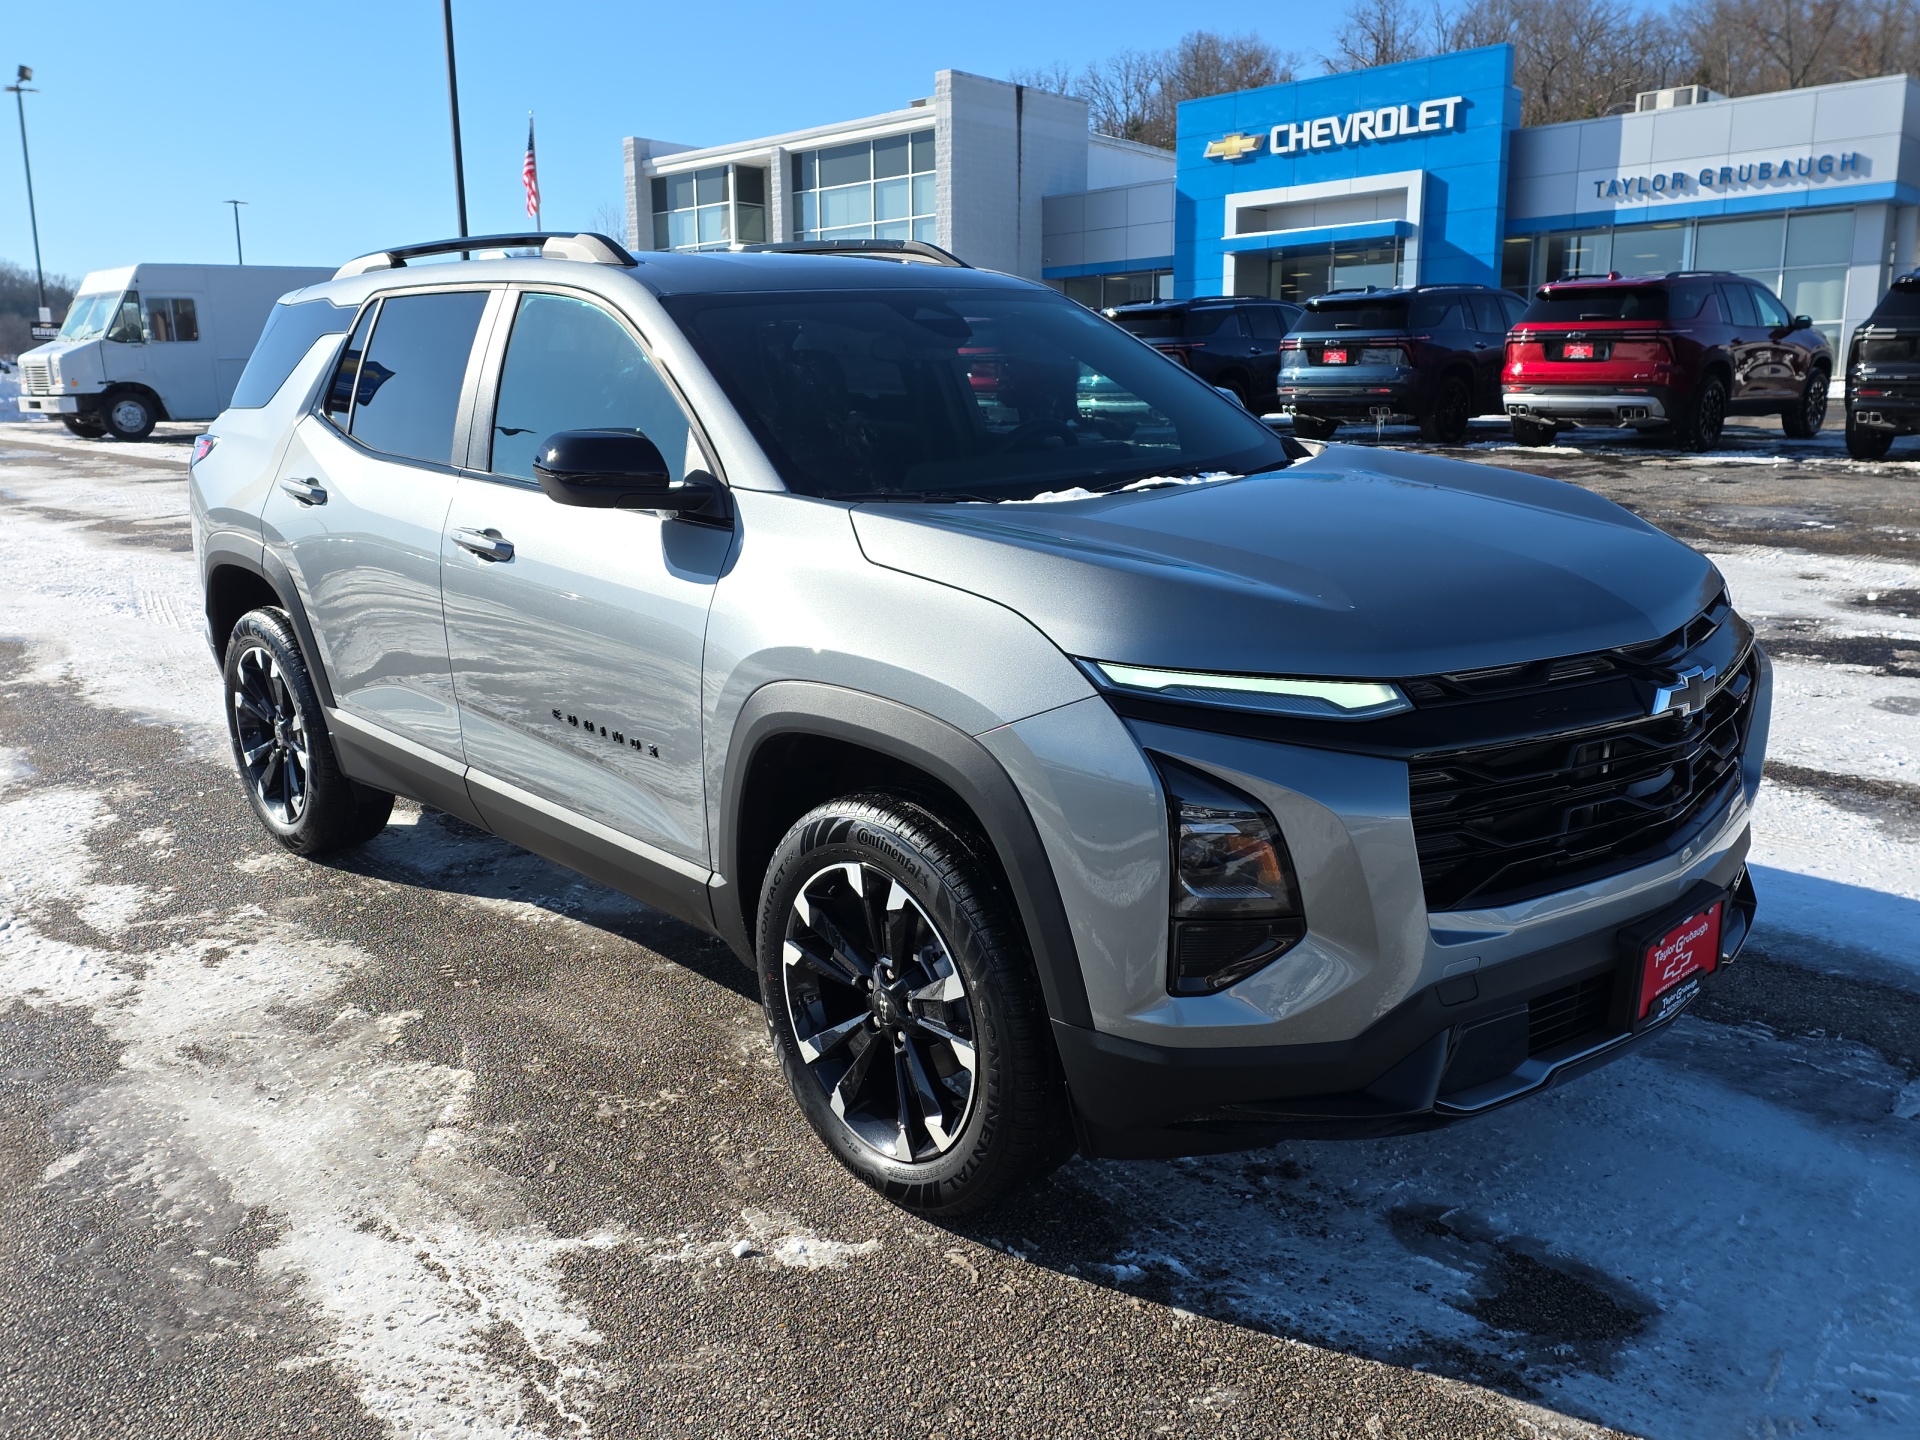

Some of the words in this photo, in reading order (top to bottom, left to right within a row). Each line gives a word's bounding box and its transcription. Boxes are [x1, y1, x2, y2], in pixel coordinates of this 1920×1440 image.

[1270, 96, 1462, 154] CHEVROLET
[1594, 172, 1685, 198] TAYLOR
[1699, 152, 1858, 187] GRUBAUGH
[552, 707, 659, 759] EQUINOX
[857, 828, 923, 879] Continental
[1655, 944, 1676, 968] Taylor
[1675, 922, 1709, 953] Grubaugh
[944, 996, 1000, 1191] CONTINENTAL
